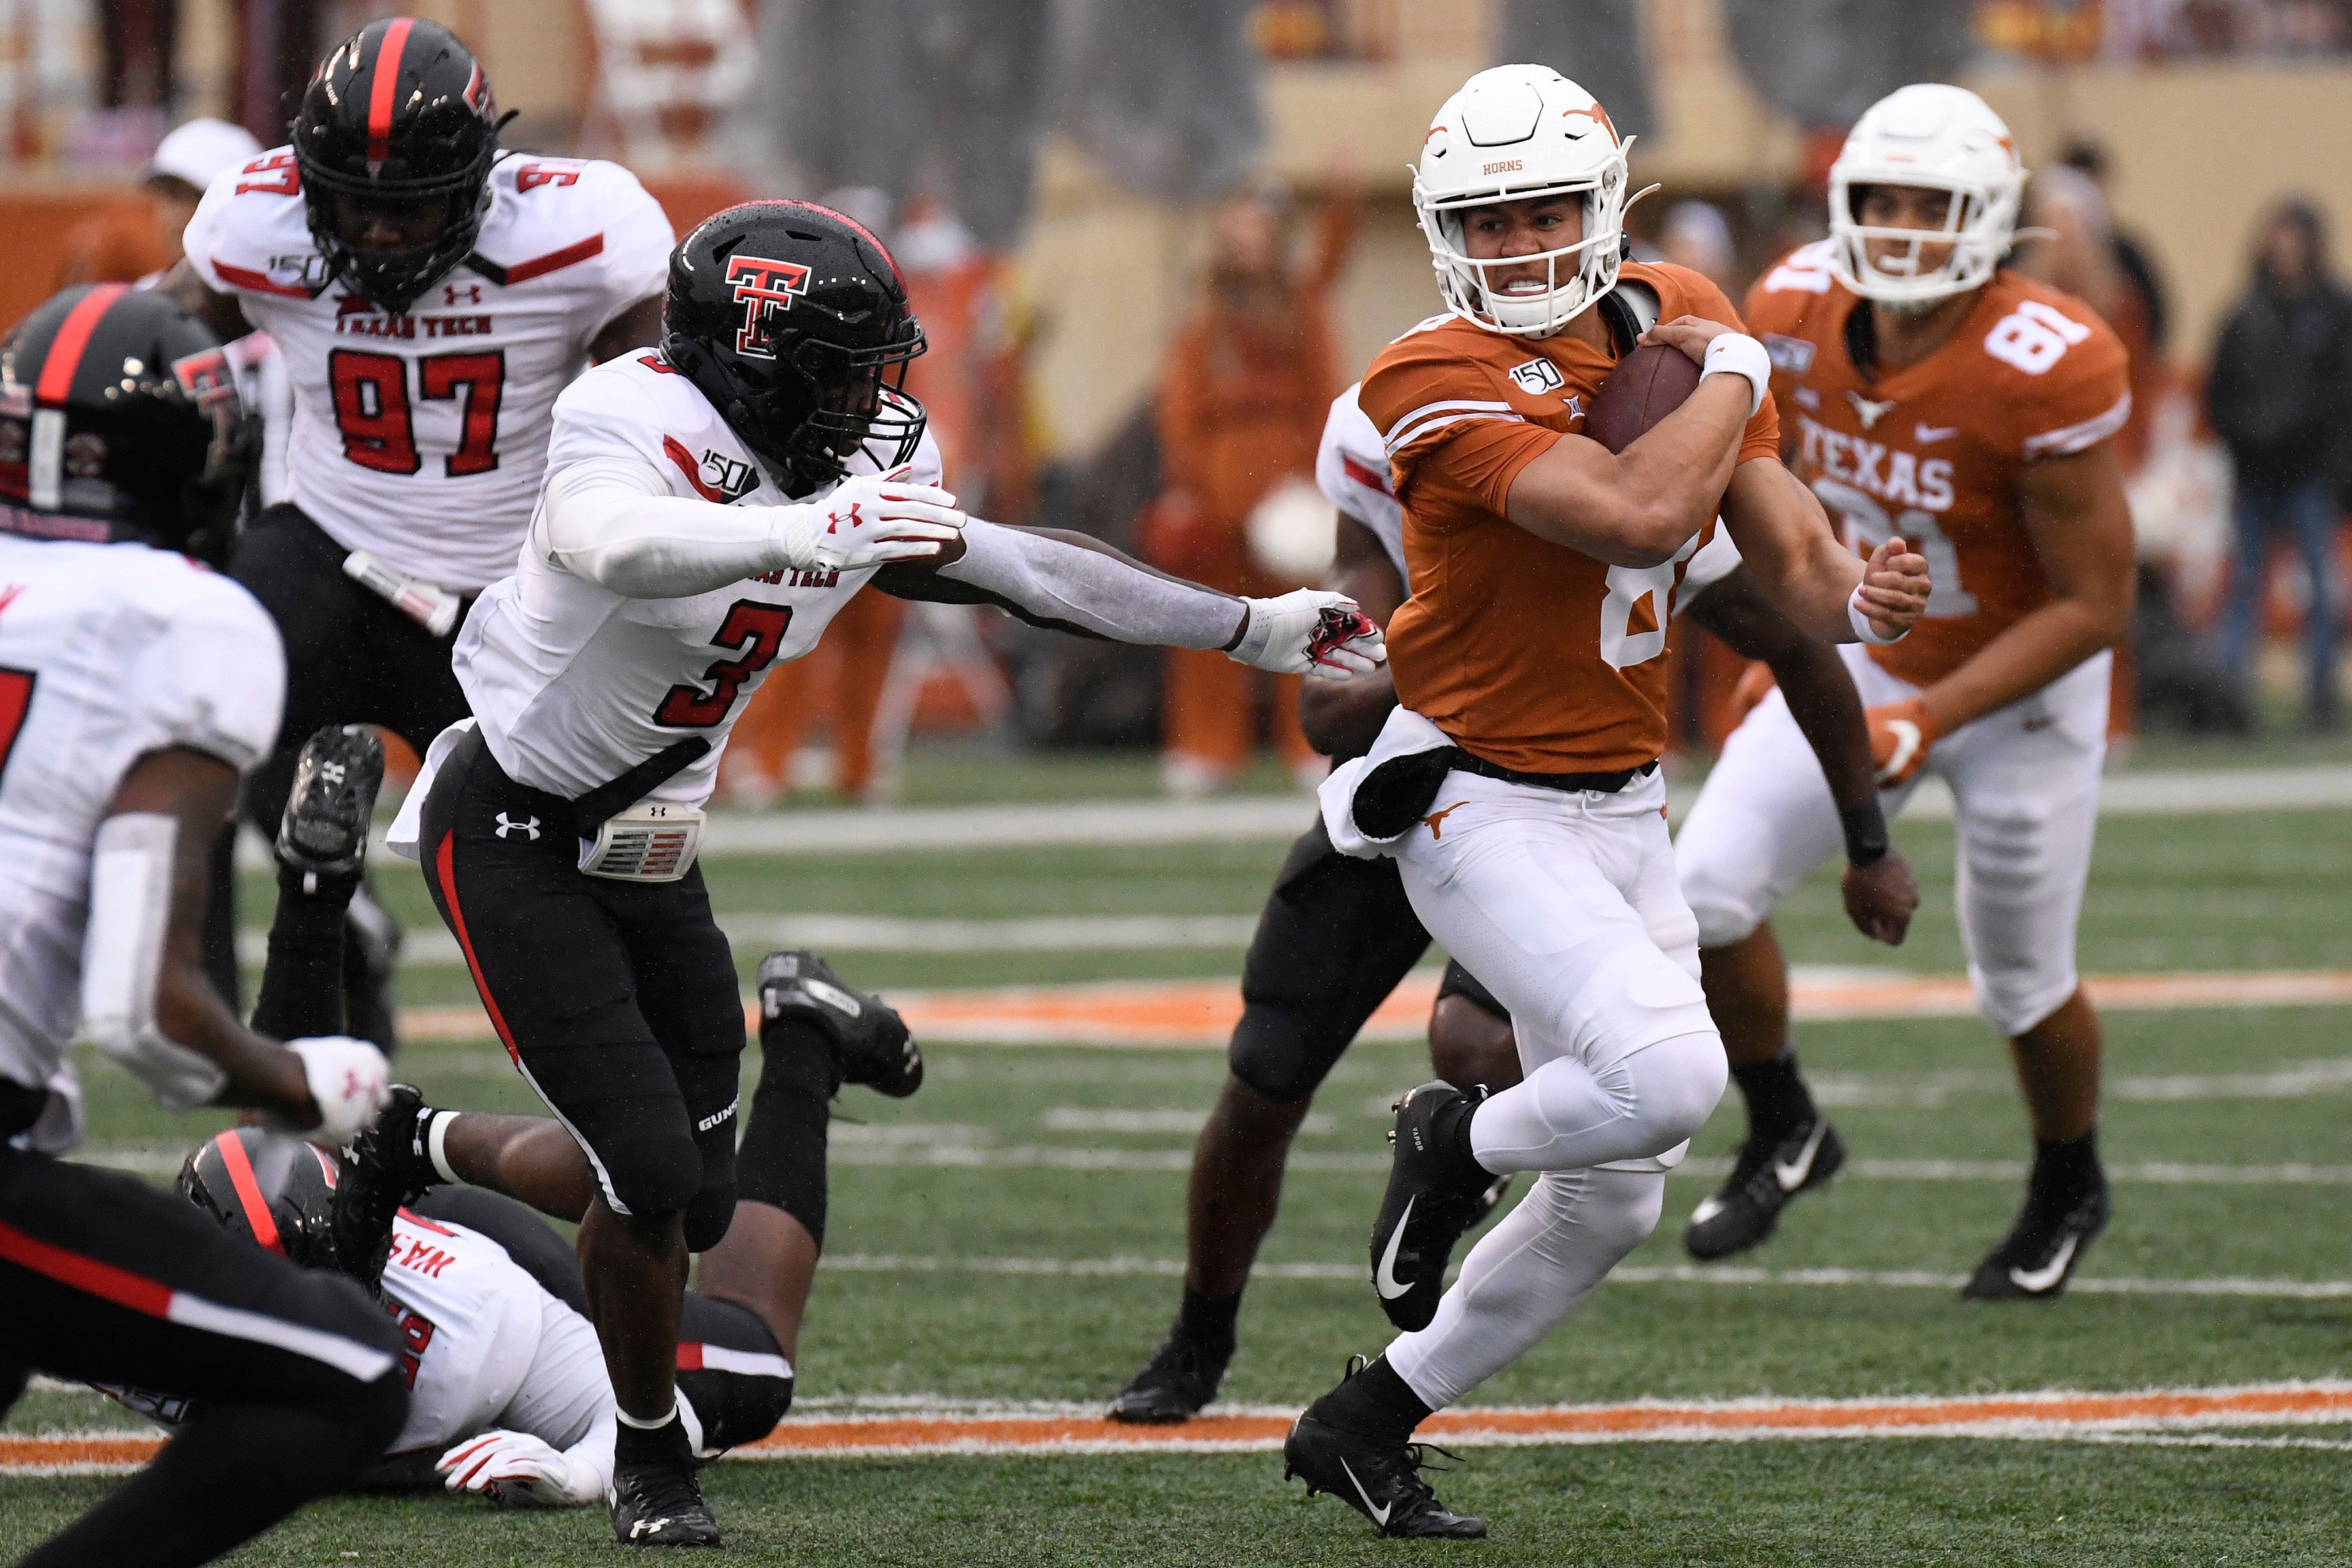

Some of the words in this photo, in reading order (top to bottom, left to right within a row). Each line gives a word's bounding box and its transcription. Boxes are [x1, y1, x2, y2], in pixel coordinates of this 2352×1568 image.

[1482, 159, 1523, 176] HORNS
[421, 315, 491, 338] TECH
[1983, 299, 2093, 376] 81
[1512, 359, 1563, 392] 150
[328, 346, 505, 478] 97
[701, 448, 749, 493] 150
[1798, 414, 1955, 512] TEXAS
[651, 598, 793, 727] 3
[1412, 1126, 1424, 1151] VAPOR
